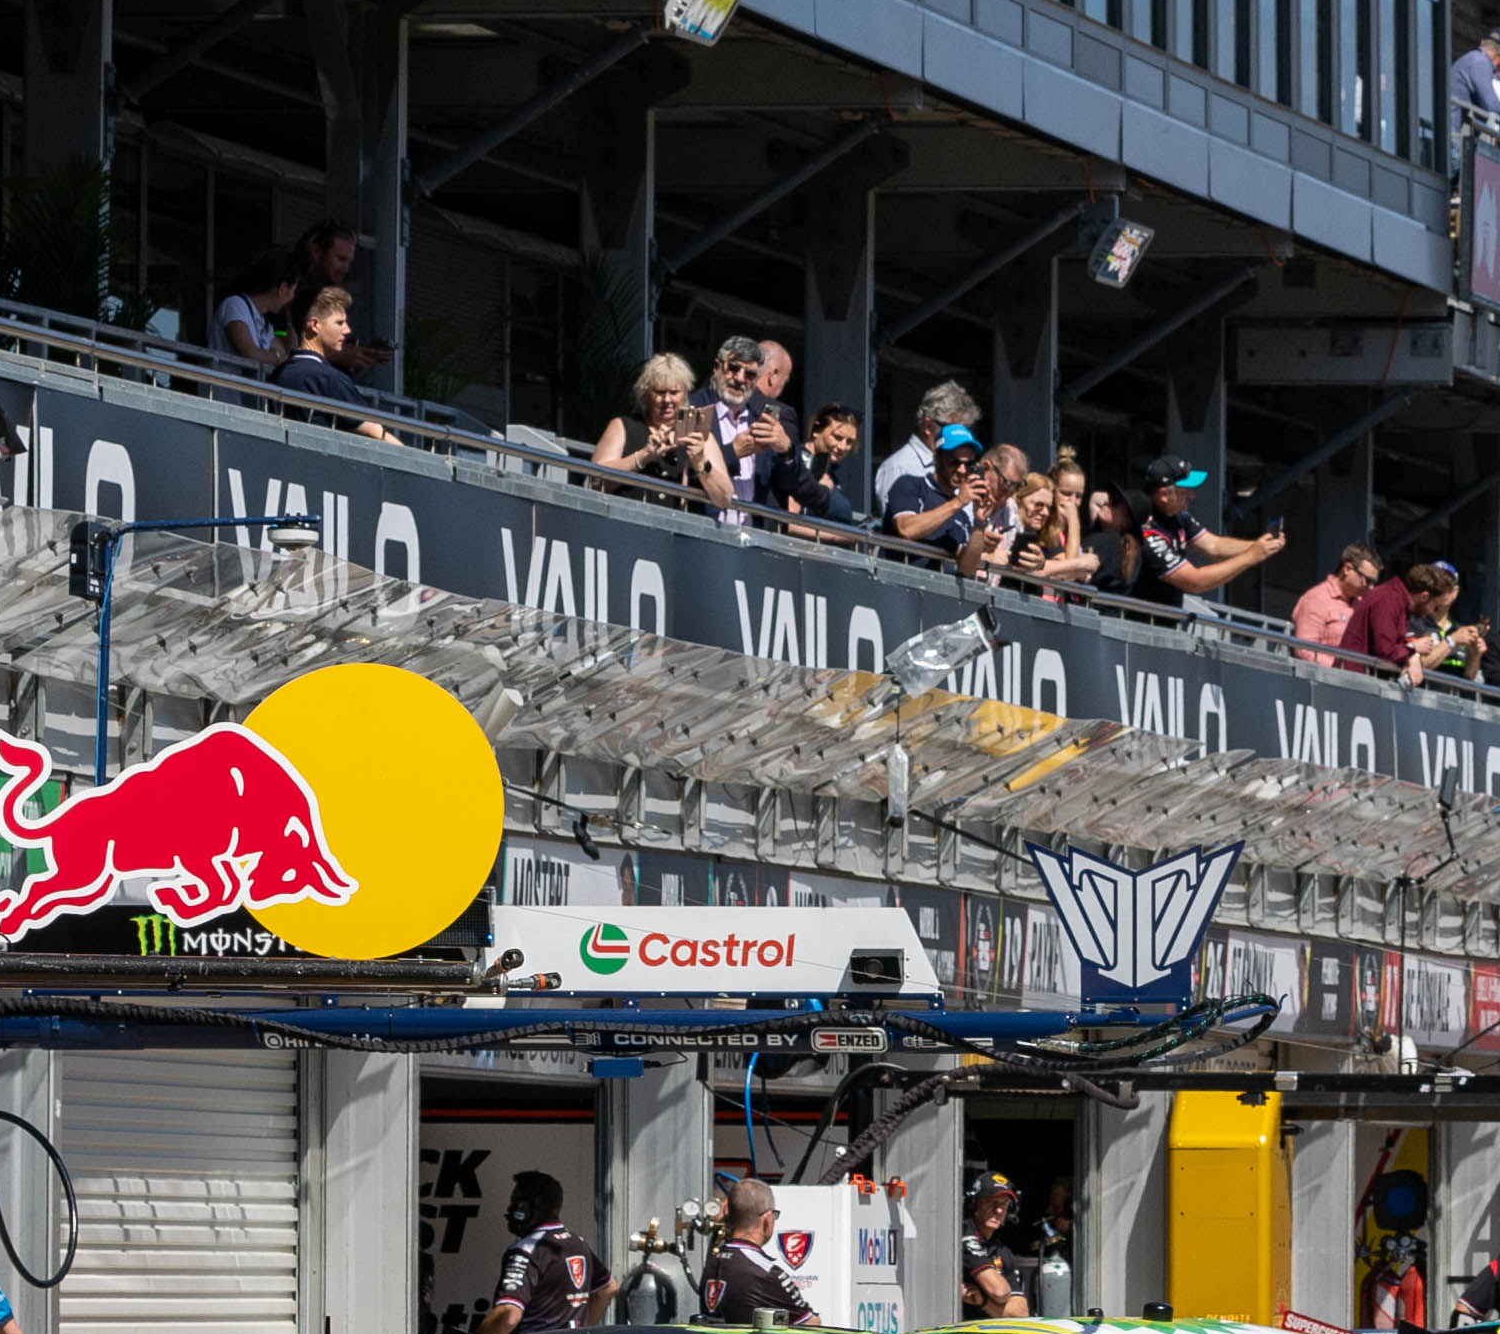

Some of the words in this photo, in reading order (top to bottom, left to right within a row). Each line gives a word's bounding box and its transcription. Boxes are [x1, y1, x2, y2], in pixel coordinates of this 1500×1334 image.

[502, 528, 667, 657] VAILO
[734, 579, 884, 672] VAILO
[1116, 664, 1227, 762] VAILO
[1275, 699, 1377, 771] VAILO
[639, 932, 795, 968] Castrol
[614, 1033, 759, 1047] CONNECTED
[767, 1033, 798, 1047] BY
[837, 1034, 881, 1048] ENZED
[857, 1302, 899, 1334] OPTUS
